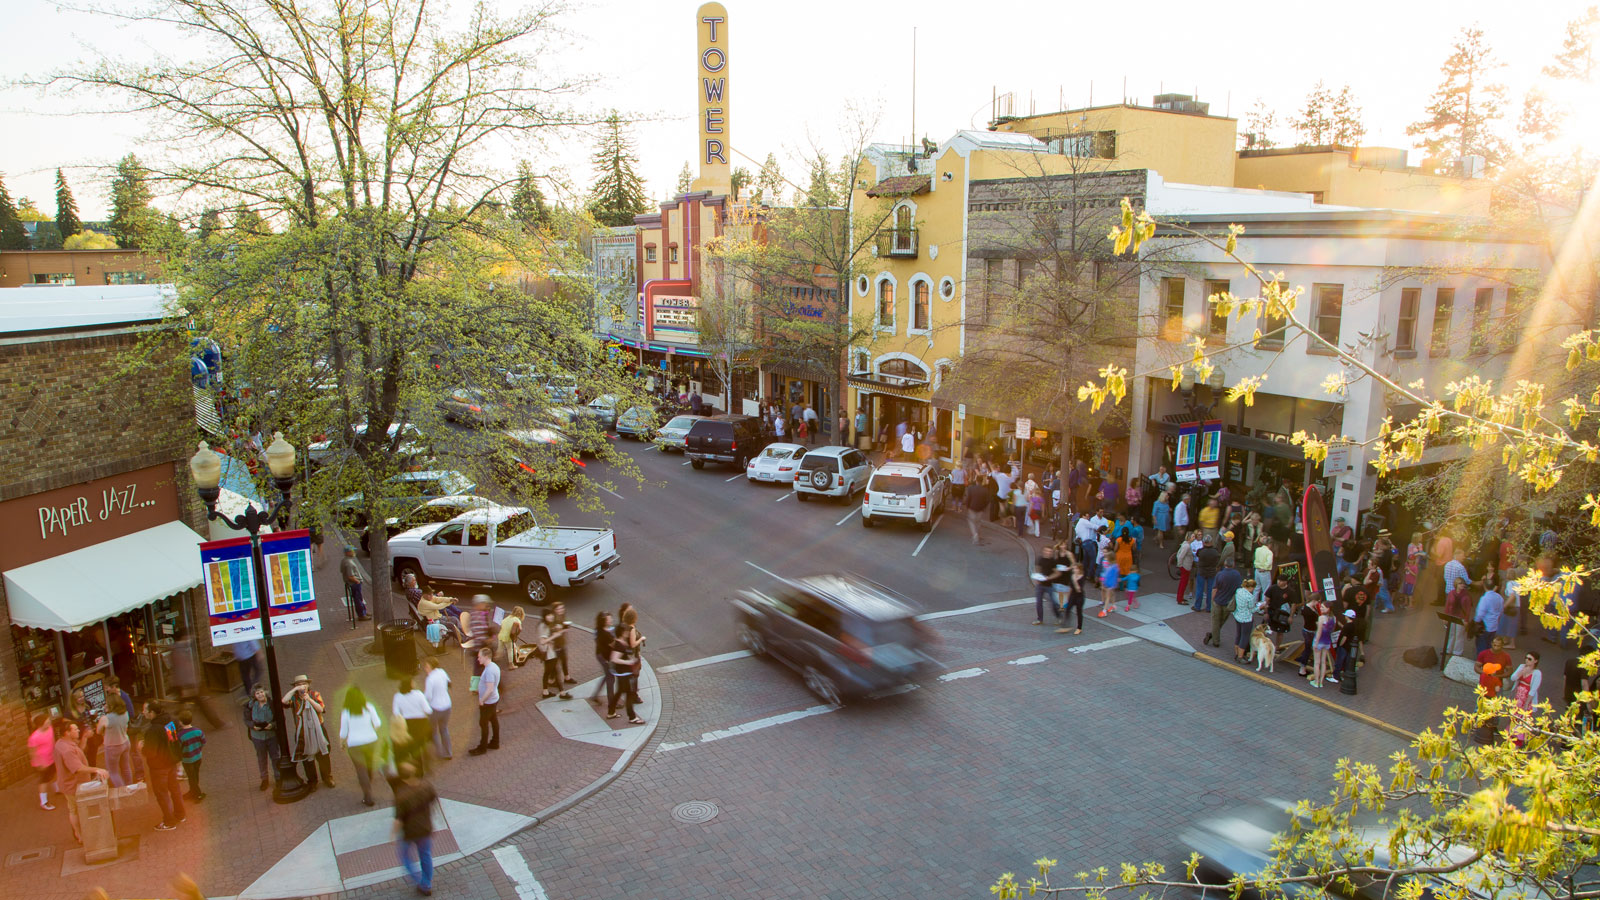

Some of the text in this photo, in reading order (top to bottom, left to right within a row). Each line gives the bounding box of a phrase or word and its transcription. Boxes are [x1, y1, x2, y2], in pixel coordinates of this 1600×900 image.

[702, 16, 727, 165] TOWER
[662, 298, 690, 307] TOWER
[38, 496, 92, 539] PAPER
